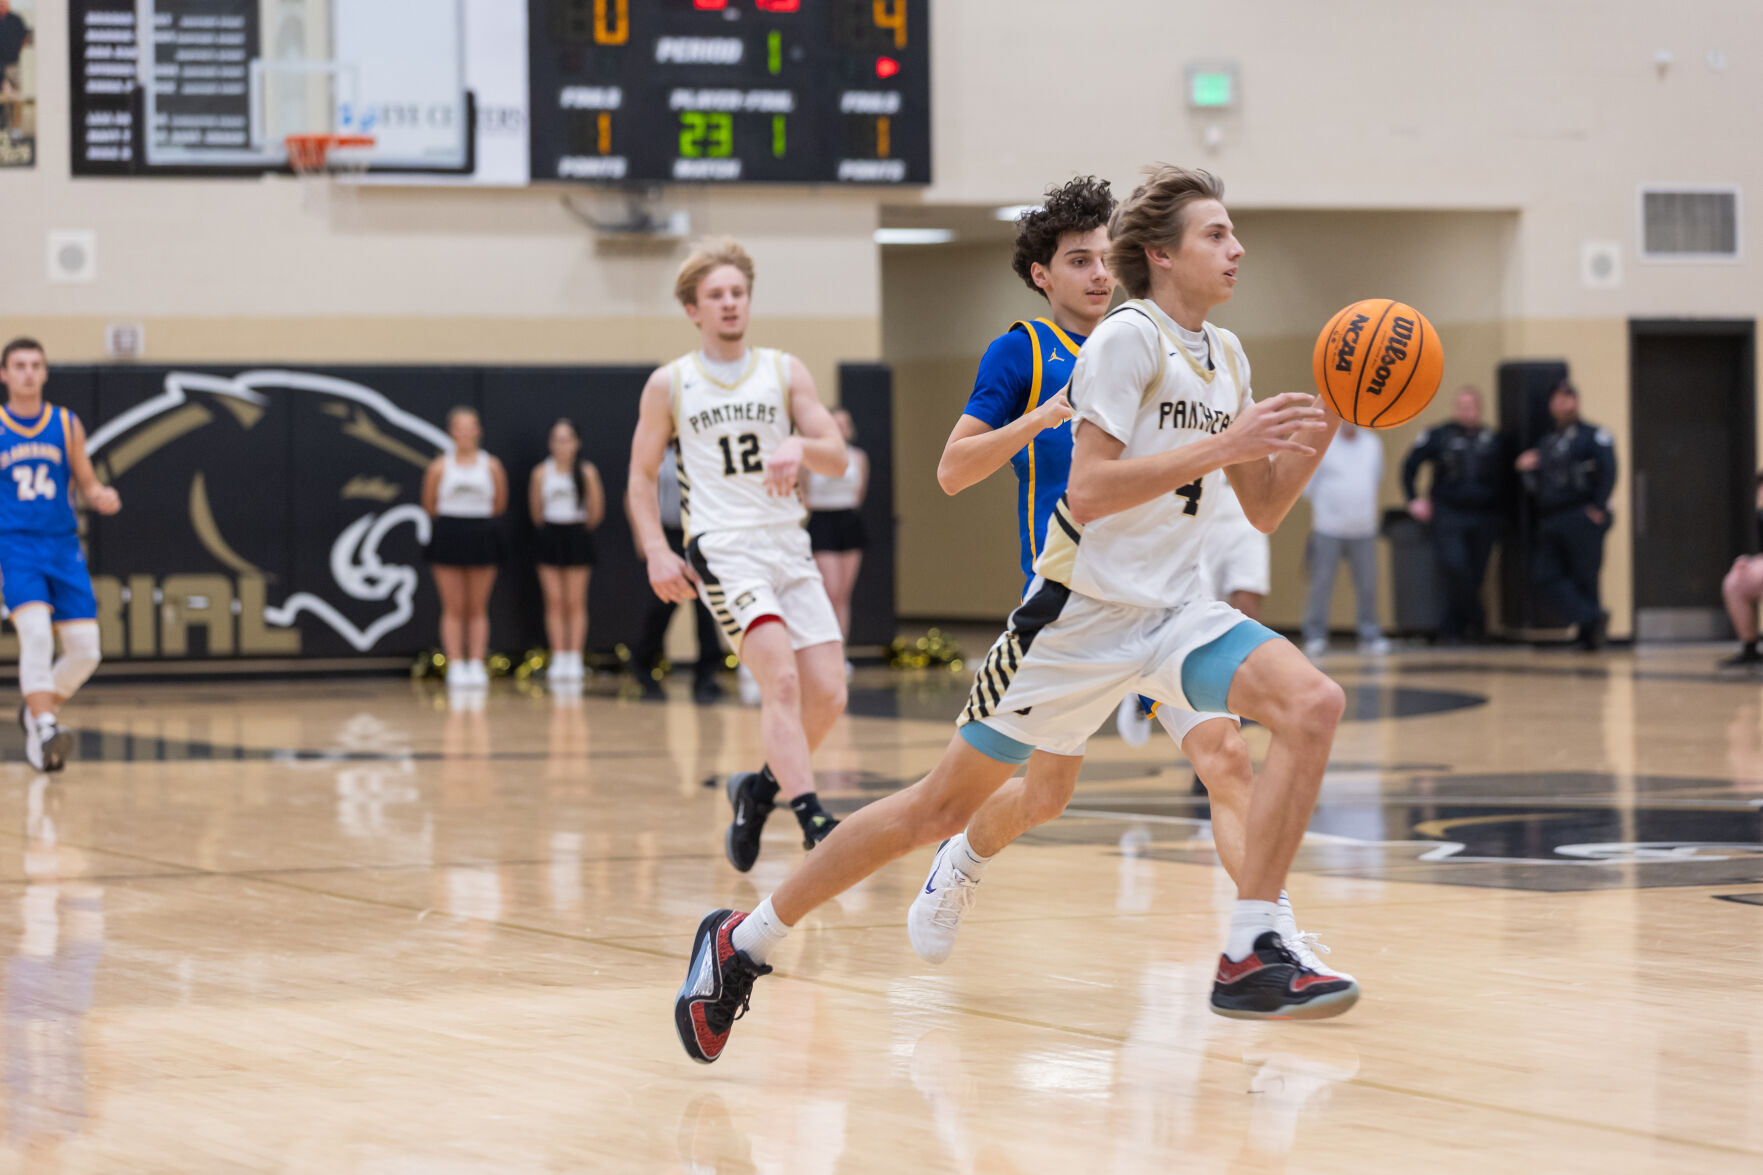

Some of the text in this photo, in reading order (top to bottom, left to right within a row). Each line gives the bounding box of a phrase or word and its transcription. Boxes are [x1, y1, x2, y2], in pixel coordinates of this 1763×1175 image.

[593, 0, 629, 45] 0
[872, 0, 907, 49] 4
[768, 29, 782, 75] 1
[597, 111, 611, 156] 1
[679, 110, 786, 159] 23 1
[877, 115, 890, 158] 1
[1335, 313, 1370, 373] NCAA
[1366, 316, 1415, 396] Wilson
[689, 402, 777, 434] PANTHERS
[1158, 400, 1234, 435] PANTHER
[718, 432, 763, 477] 12
[12, 463, 57, 501] 24
[1174, 476, 1203, 516] 4
